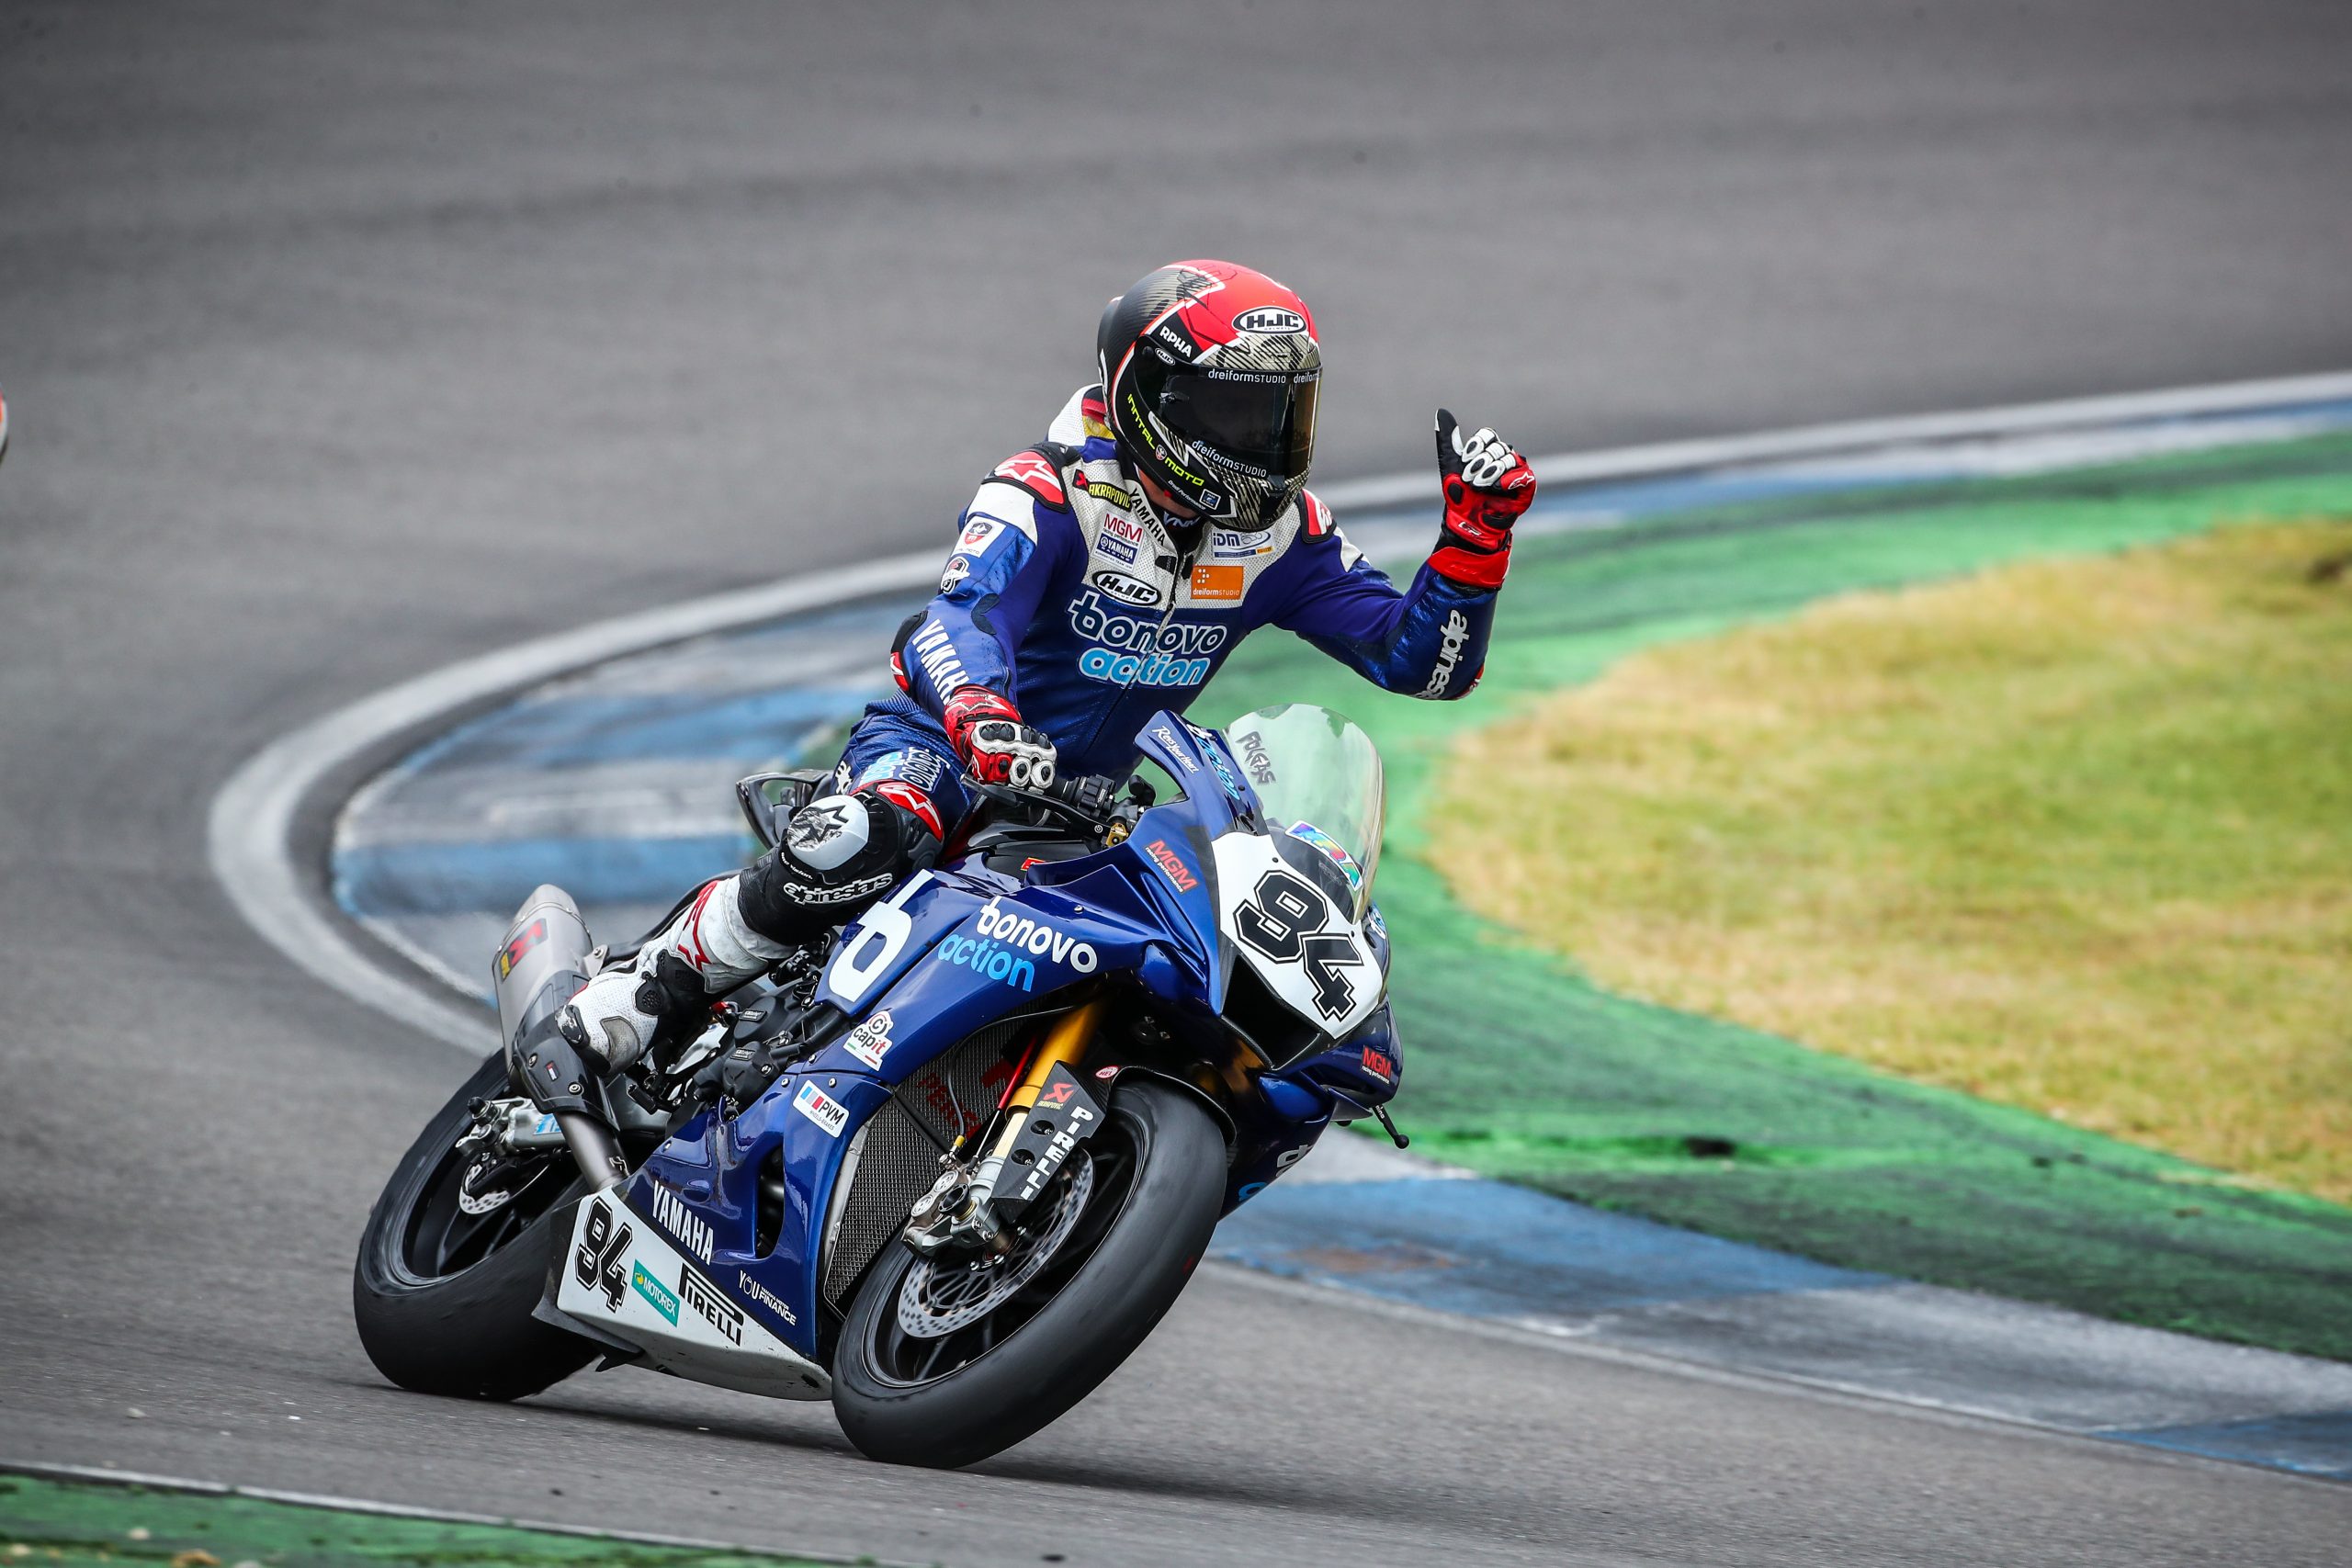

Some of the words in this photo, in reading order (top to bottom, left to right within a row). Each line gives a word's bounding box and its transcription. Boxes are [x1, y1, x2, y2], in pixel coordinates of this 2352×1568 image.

[1247, 314, 1299, 329] HJC
[1159, 326, 1192, 357] RPHA
[1165, 457, 1204, 486] MOTO
[1104, 513, 1143, 543] MGM
[1129, 488, 1166, 547] YAMAHA
[1108, 539, 1135, 559] YAMAHA
[1099, 575, 1156, 602] HJC
[1069, 591, 1227, 654] bonovo
[912, 618, 970, 705] YAMAH
[1079, 648, 1211, 687] action
[1149, 840, 1198, 890] MGM
[783, 873, 894, 906] alpinestars
[978, 896, 1098, 974] bonovo
[1232, 870, 1364, 1021] 94
[937, 932, 1035, 993] action
[853, 1028, 887, 1055] capit
[1363, 1047, 1392, 1079] MGM
[818, 1100, 845, 1125] PVM
[1020, 1105, 1094, 1201] PIRELLI
[652, 1179, 714, 1266] YAMAHA
[574, 1195, 633, 1314] 94
[643, 1277, 677, 1317] MOTOREX
[739, 1269, 761, 1300] YOU
[678, 1262, 744, 1347] PIRELLI
[759, 1291, 797, 1326] FINANCE
